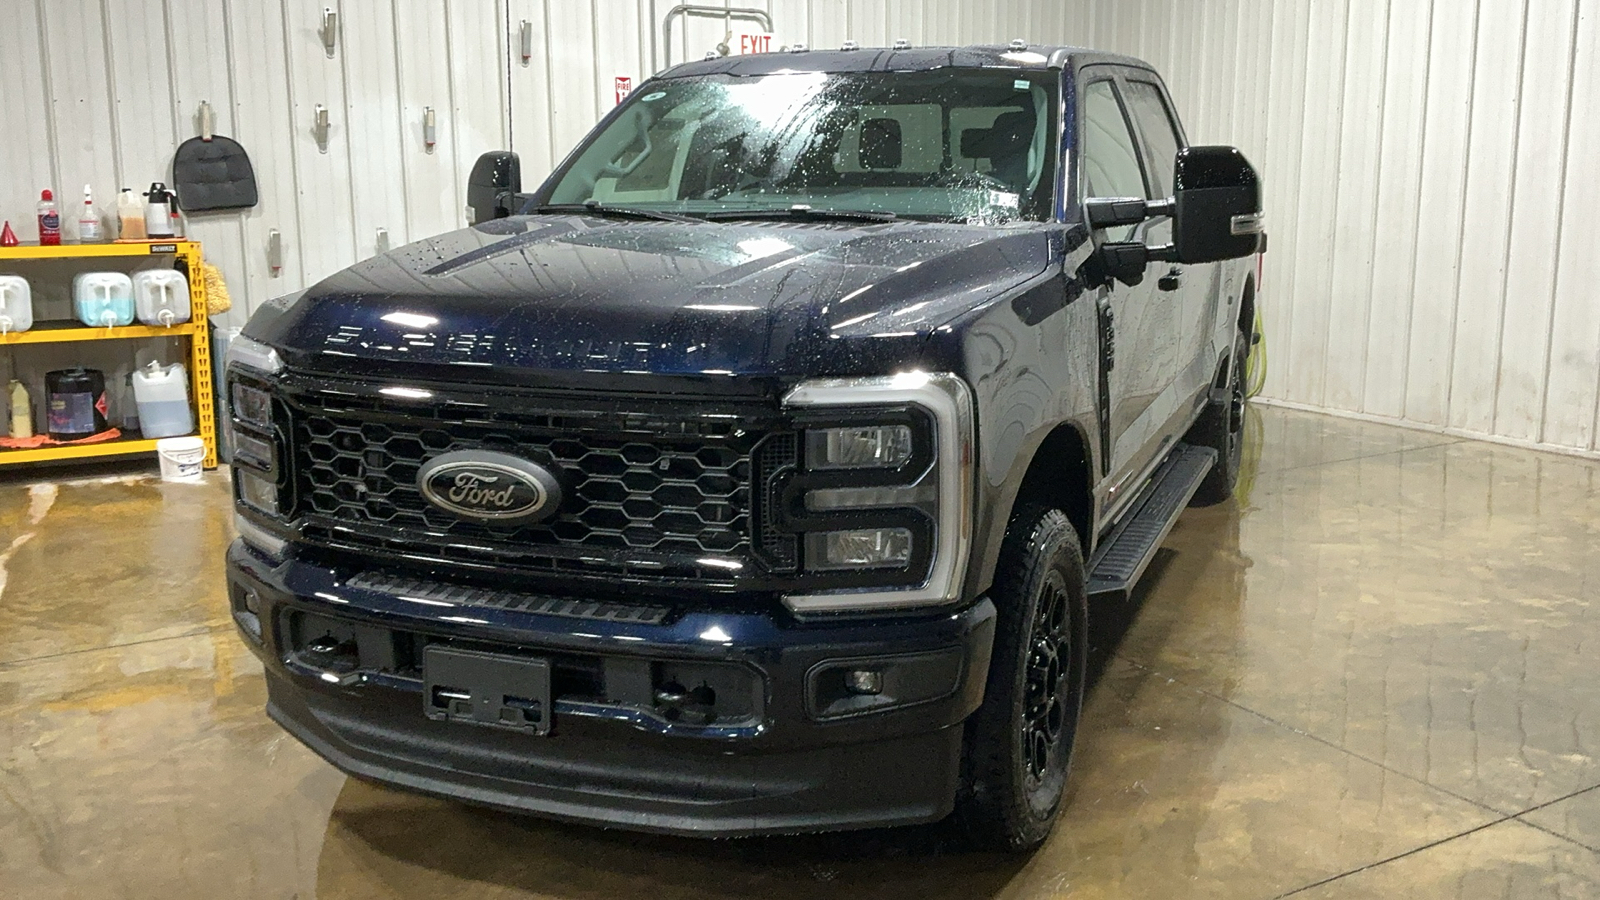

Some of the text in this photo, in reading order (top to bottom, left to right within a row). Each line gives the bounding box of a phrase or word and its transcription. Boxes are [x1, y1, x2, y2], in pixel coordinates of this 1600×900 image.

[741, 34, 772, 54] EXIT
[617, 83, 629, 91] FIRE
[449, 472, 515, 507] Ford
